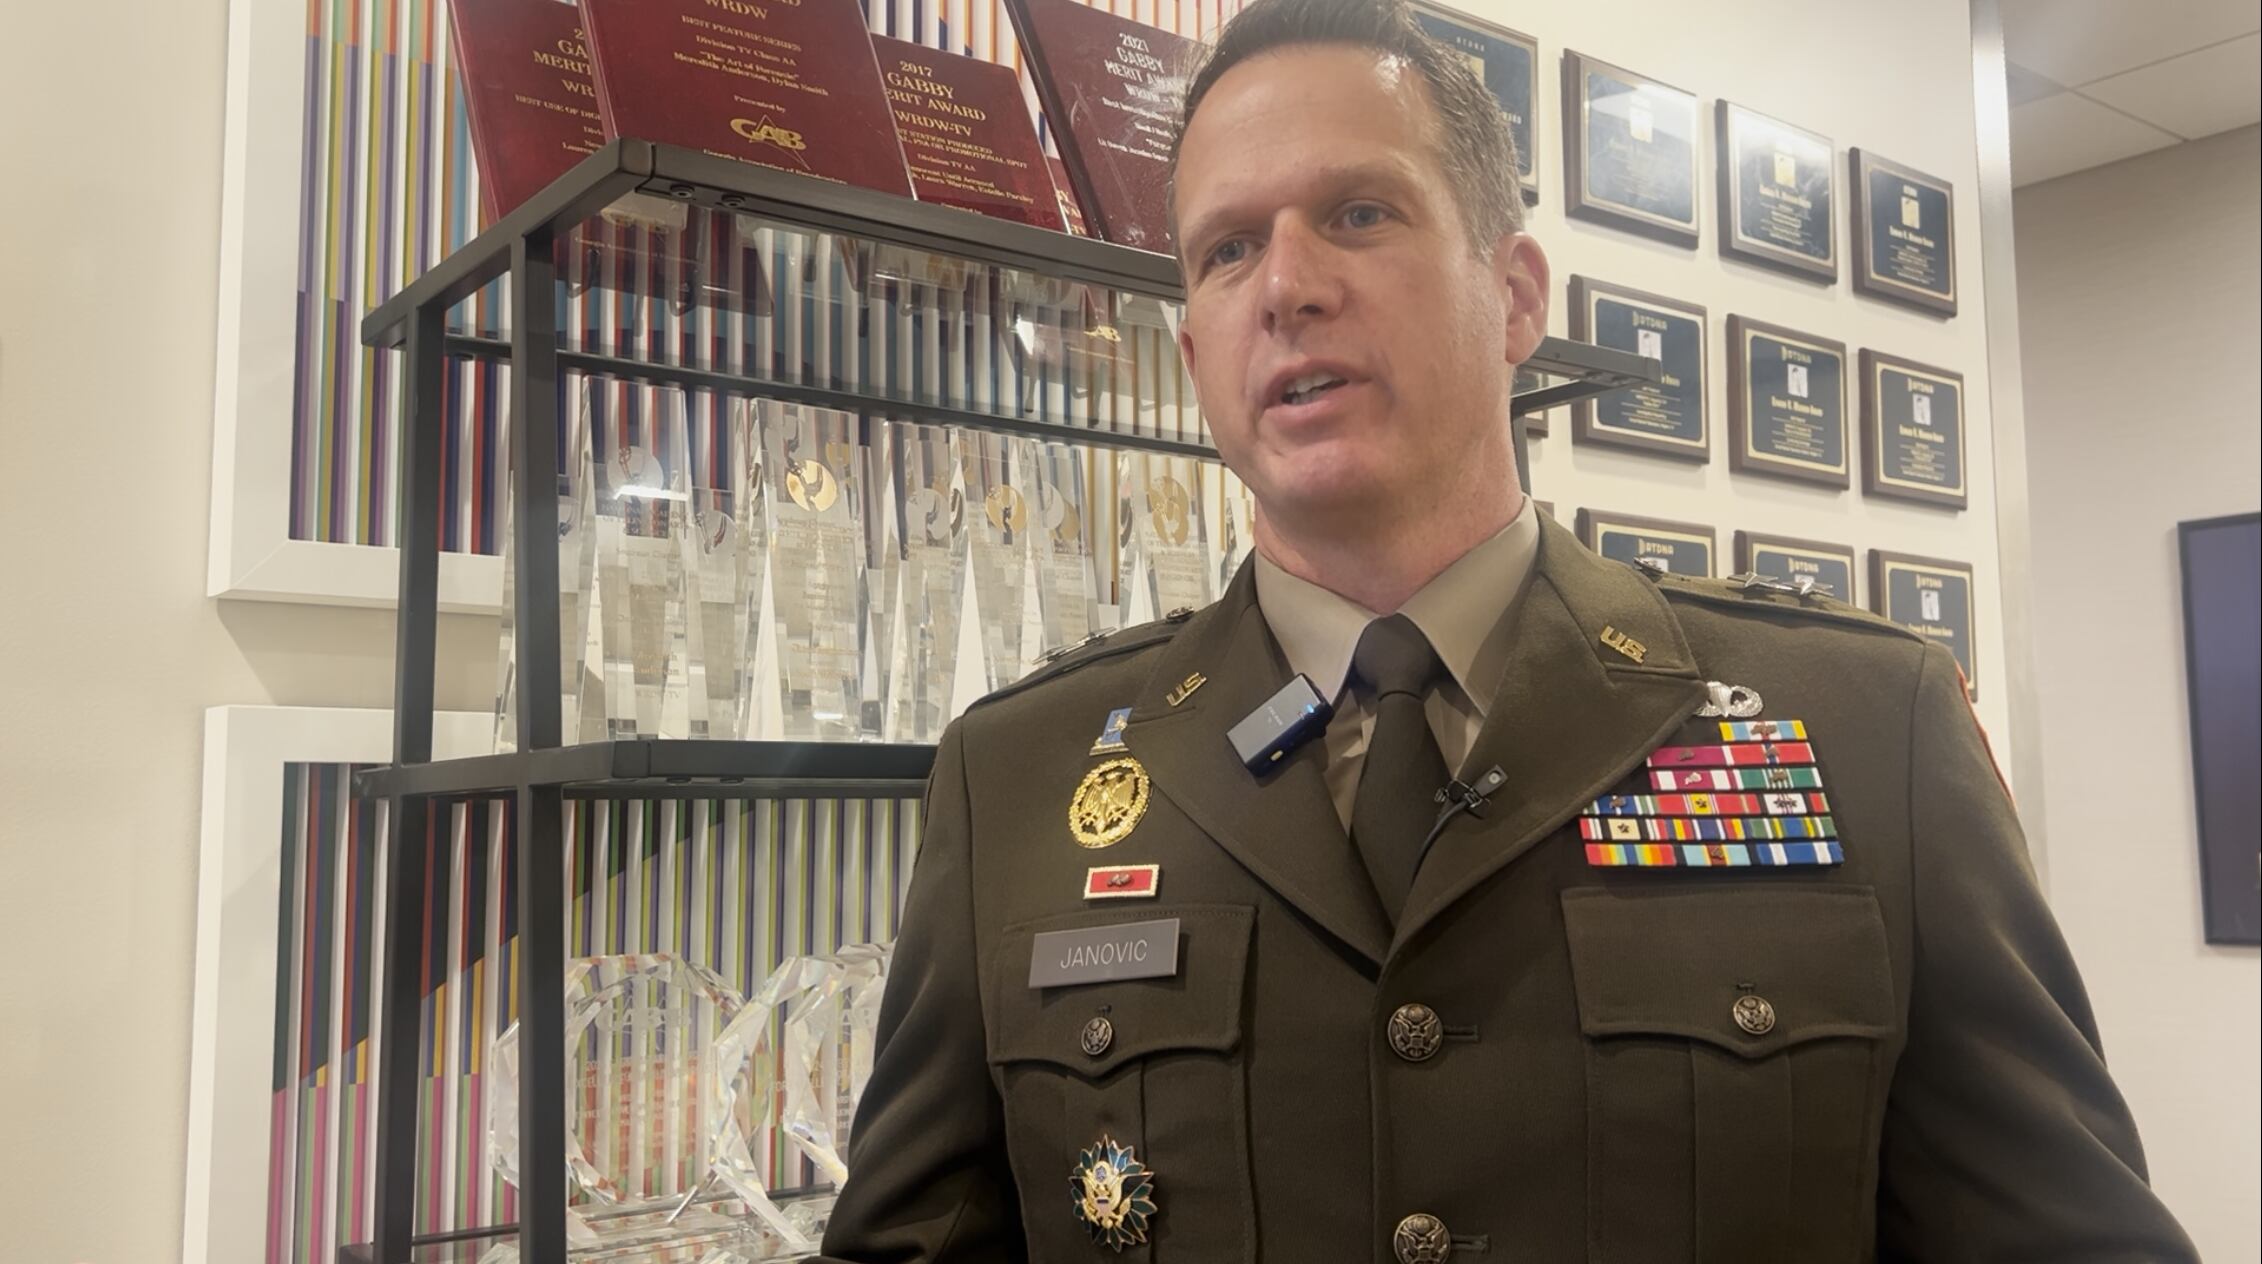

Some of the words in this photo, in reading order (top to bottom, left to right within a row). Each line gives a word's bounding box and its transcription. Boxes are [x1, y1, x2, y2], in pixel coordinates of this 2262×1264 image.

[1118, 32, 1150, 53] 2021
[782, 57, 797, 67] AA
[899, 60, 932, 78] 2017
[1104, 59, 1143, 82] MERIT
[1116, 46, 1165, 74] GABBY
[562, 79, 596, 98] WR
[887, 72, 954, 99] GABBY
[886, 87, 923, 106] ERIT
[927, 98, 987, 121] AWARD
[894, 109, 972, 137] WRDW-TV
[1060, 939, 1148, 969] JANOVIC
